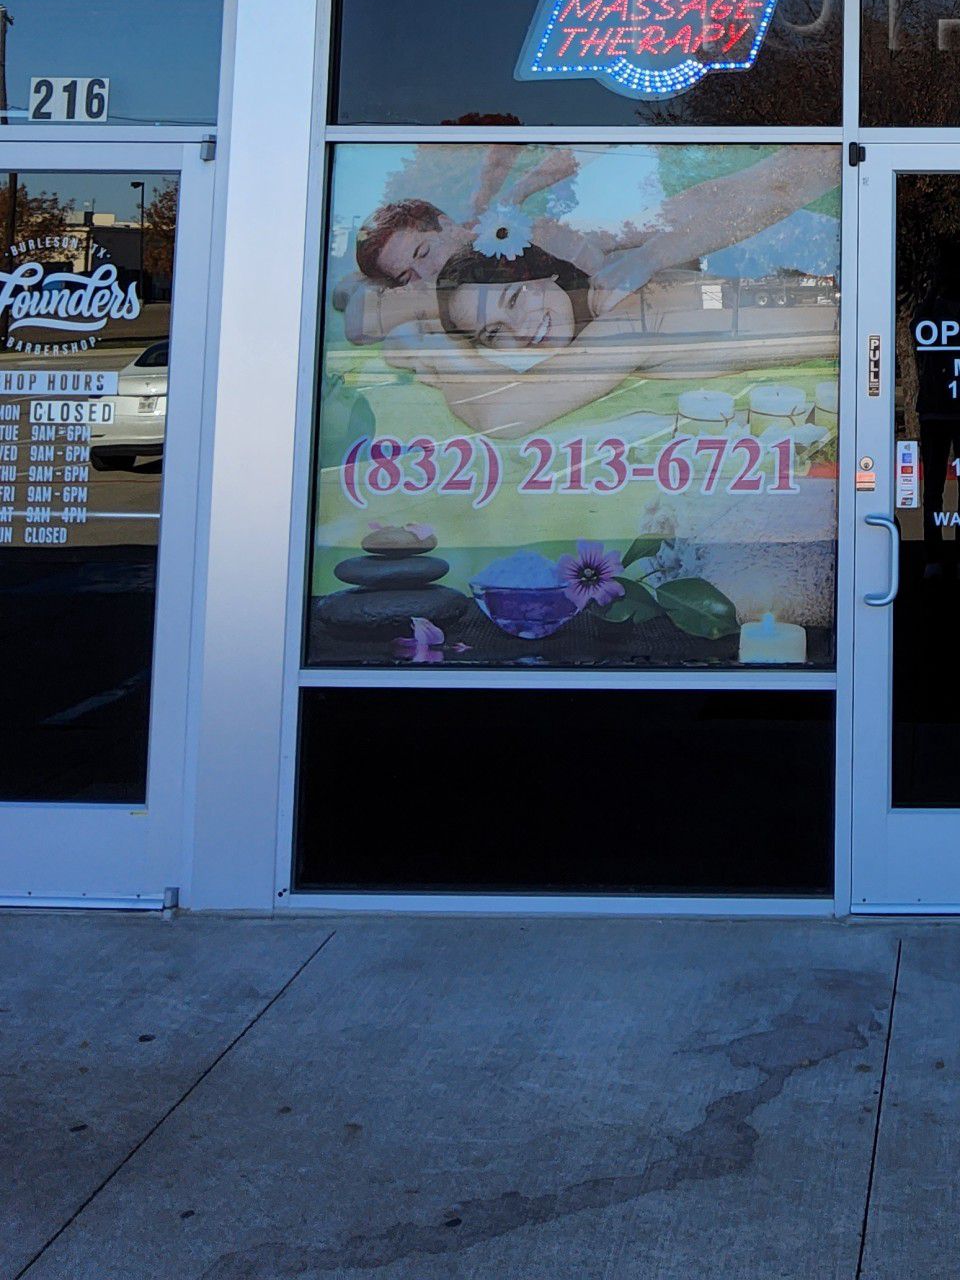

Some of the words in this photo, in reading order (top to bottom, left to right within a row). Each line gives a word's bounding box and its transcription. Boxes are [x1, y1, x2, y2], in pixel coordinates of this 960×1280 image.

[557, 23, 751, 57] THERAPY
[31, 78, 107, 120] 216
[6, 336, 97, 356] BARBERSHOP
[870, 339, 880, 382] PULL
[4, 373, 37, 391] HOP
[47, 373, 105, 391] HOURS
[33, 402, 112, 422] CLOSED
[0, 424, 19, 441] TUE
[31, 425, 56, 442] 9AM
[66, 425, 91, 442] 6PM
[30, 445, 55, 462] 9AM
[65, 446, 90, 462] 6PM
[28, 465, 53, 482] 9AM
[64, 466, 89, 482] 6PM
[343, 437, 501, 508] (832)
[518, 436, 800, 496] 213-6721
[27, 486, 52, 503] 9AM
[62, 487, 88, 503] 6PM
[0, 507, 14, 523] AT
[26, 507, 51, 523] 9AM
[61, 507, 87, 523] 4PM
[24, 527, 68, 544] CLOSED
